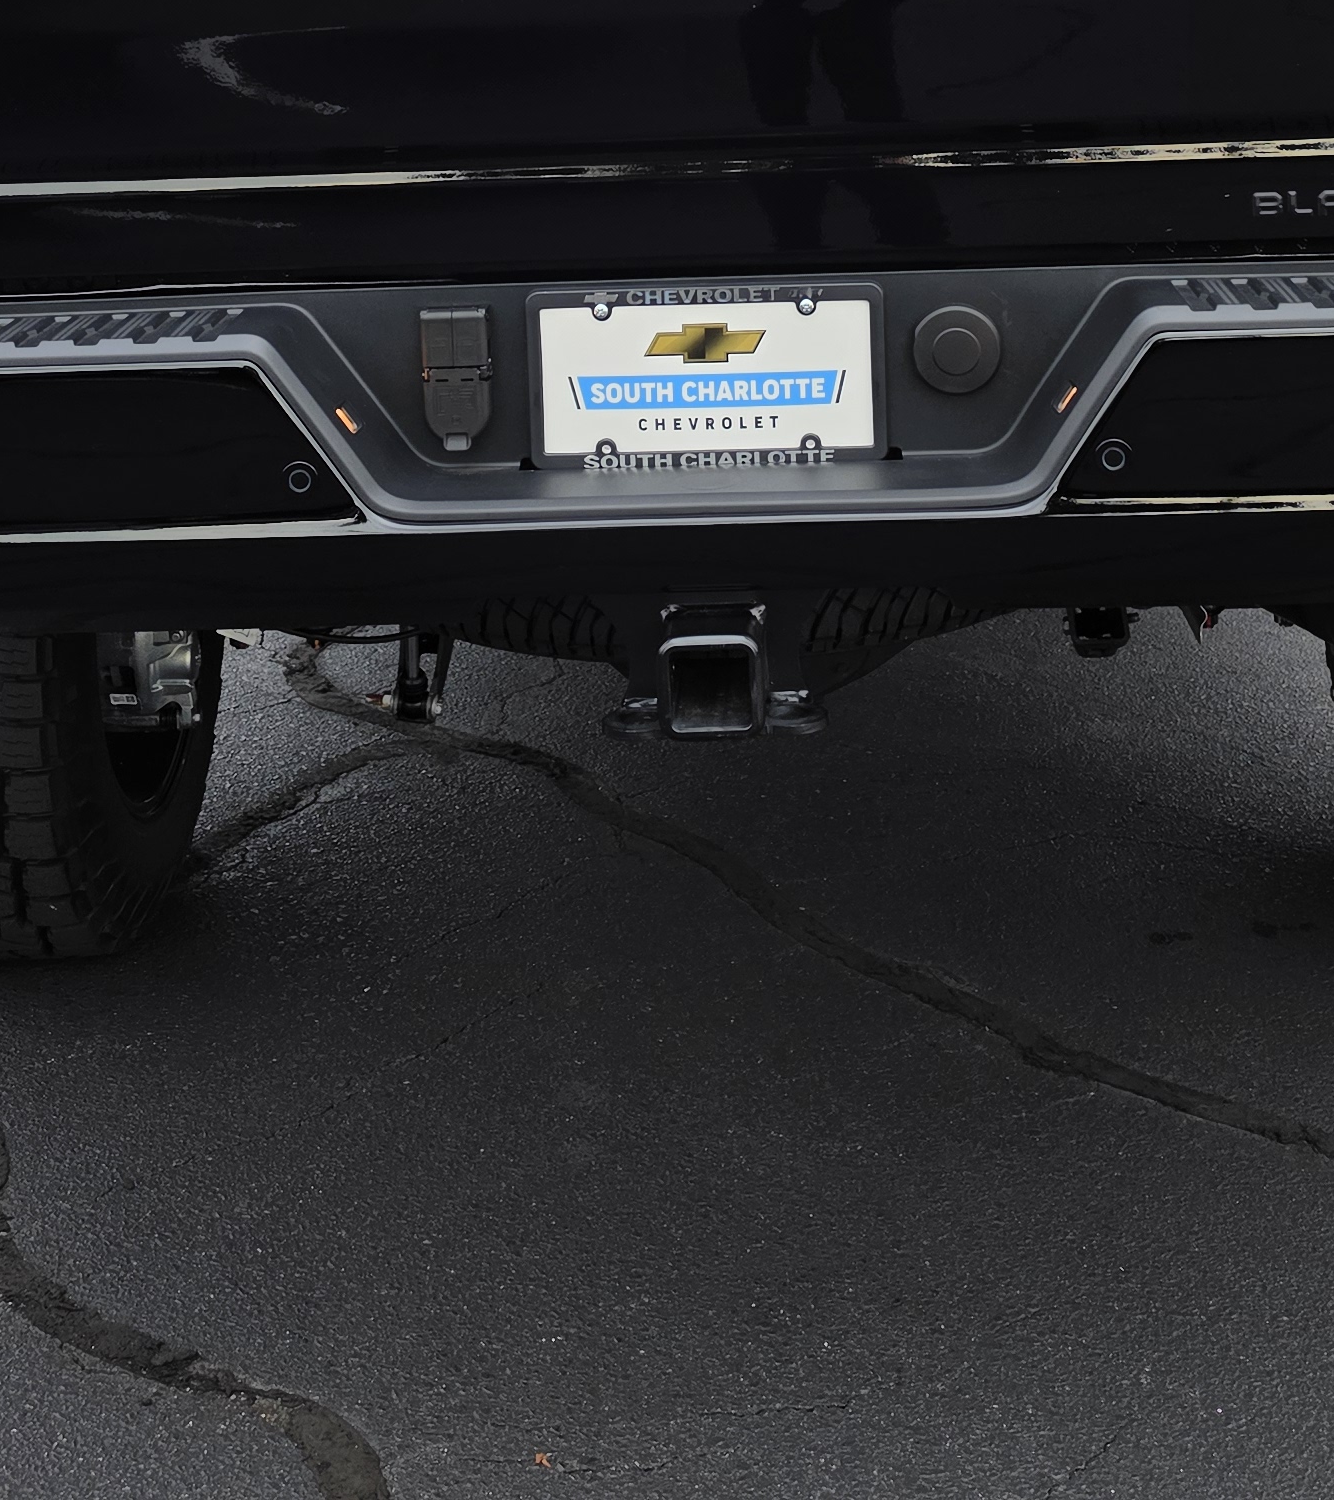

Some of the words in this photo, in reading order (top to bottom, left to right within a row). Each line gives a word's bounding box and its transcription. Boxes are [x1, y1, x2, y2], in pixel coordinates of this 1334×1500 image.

[625, 286, 781, 306] CHEVROLET
[590, 381, 674, 404] SOUTH
[681, 377, 826, 402] CHARLOTTE
[638, 415, 780, 432] CHEVROLET
[583, 452, 673, 470] SOUTH
[679, 449, 835, 468] CHARLOTTE
